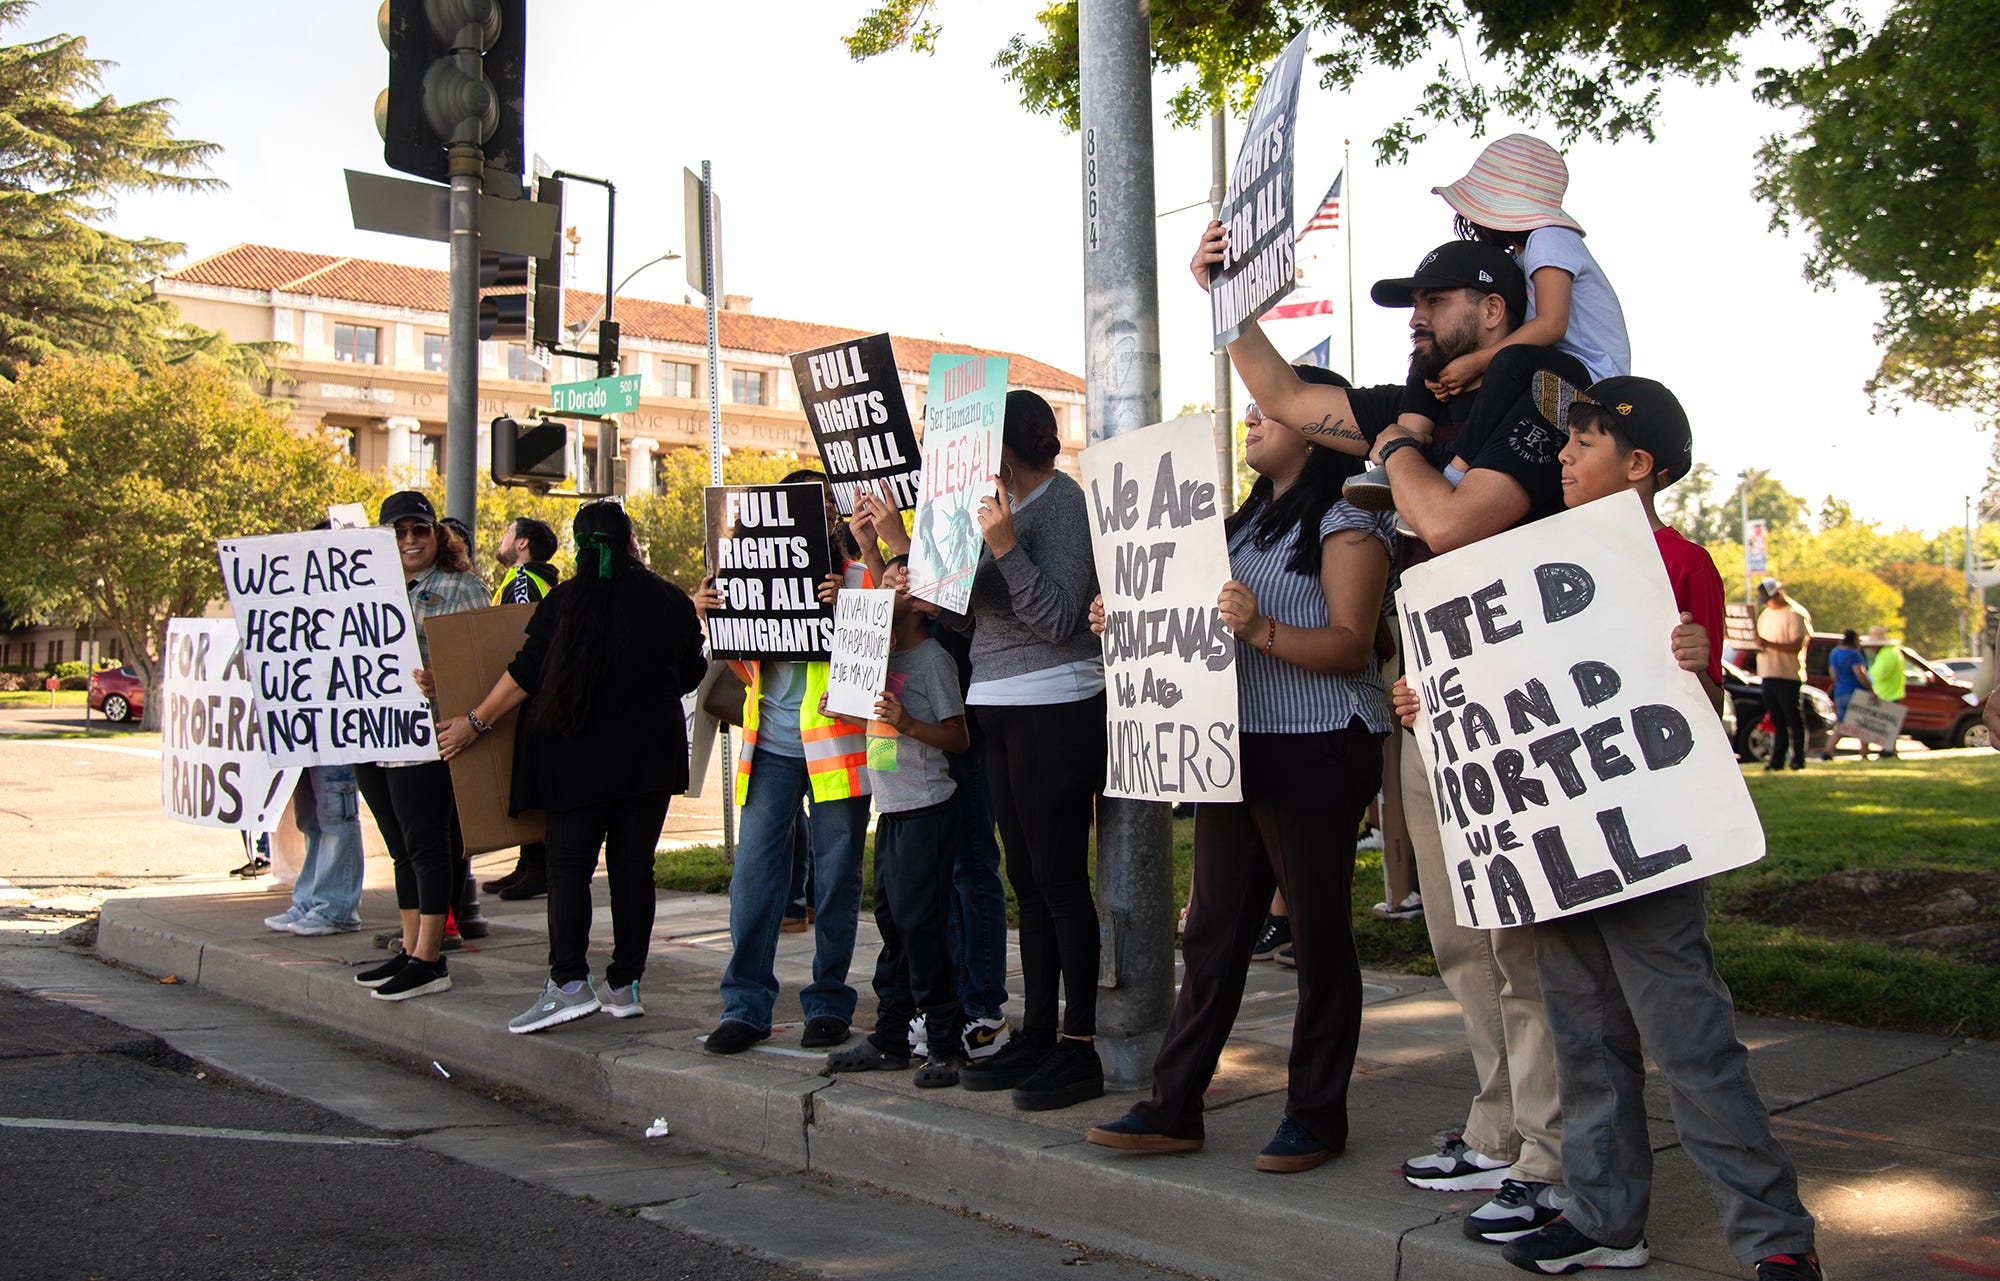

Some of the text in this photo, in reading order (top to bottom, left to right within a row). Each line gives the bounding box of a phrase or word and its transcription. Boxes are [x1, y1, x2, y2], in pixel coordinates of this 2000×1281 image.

[1087, 128, 1098, 250] 8864
[1221, 172, 1286, 271] FOR ALL
[1213, 228, 1295, 336] IMMIGRANTS
[620, 379, 639, 393] 500 N
[808, 346, 870, 392] FULL
[553, 386, 607, 410] El Dorado
[621, 414, 663, 429] CIVIC
[625, 395, 633, 407] St
[813, 390, 889, 434] RIGHTS
[824, 432, 907, 475] FOR ALL
[726, 491, 795, 528] FULL
[1091, 451, 1217, 536] We Are
[303, 547, 376, 596] ARE
[718, 536, 810, 569] RIGHTS
[1115, 541, 1177, 601] NOT
[715, 577, 821, 610] FOR ALL
[872, 600, 889, 629] LOS
[1404, 562, 1597, 672] ITED
[245, 602, 406, 652] HERE AND
[708, 617, 835, 652] IMMIGRANTS
[1103, 606, 1235, 672] CRIMINALS
[169, 632, 211, 682] FOR
[260, 654, 403, 703] WE ARE
[1115, 667, 1184, 709] We Are
[1421, 667, 1467, 715] WE
[171, 691, 268, 752] PROGRA
[266, 707, 323, 755] NOT
[1431, 660, 1622, 765] TAND
[1108, 719, 1235, 797] WORKERS
[1434, 703, 1695, 829] PORTED
[1465, 819, 1524, 857] WE
[1457, 806, 1693, 927] FALL
